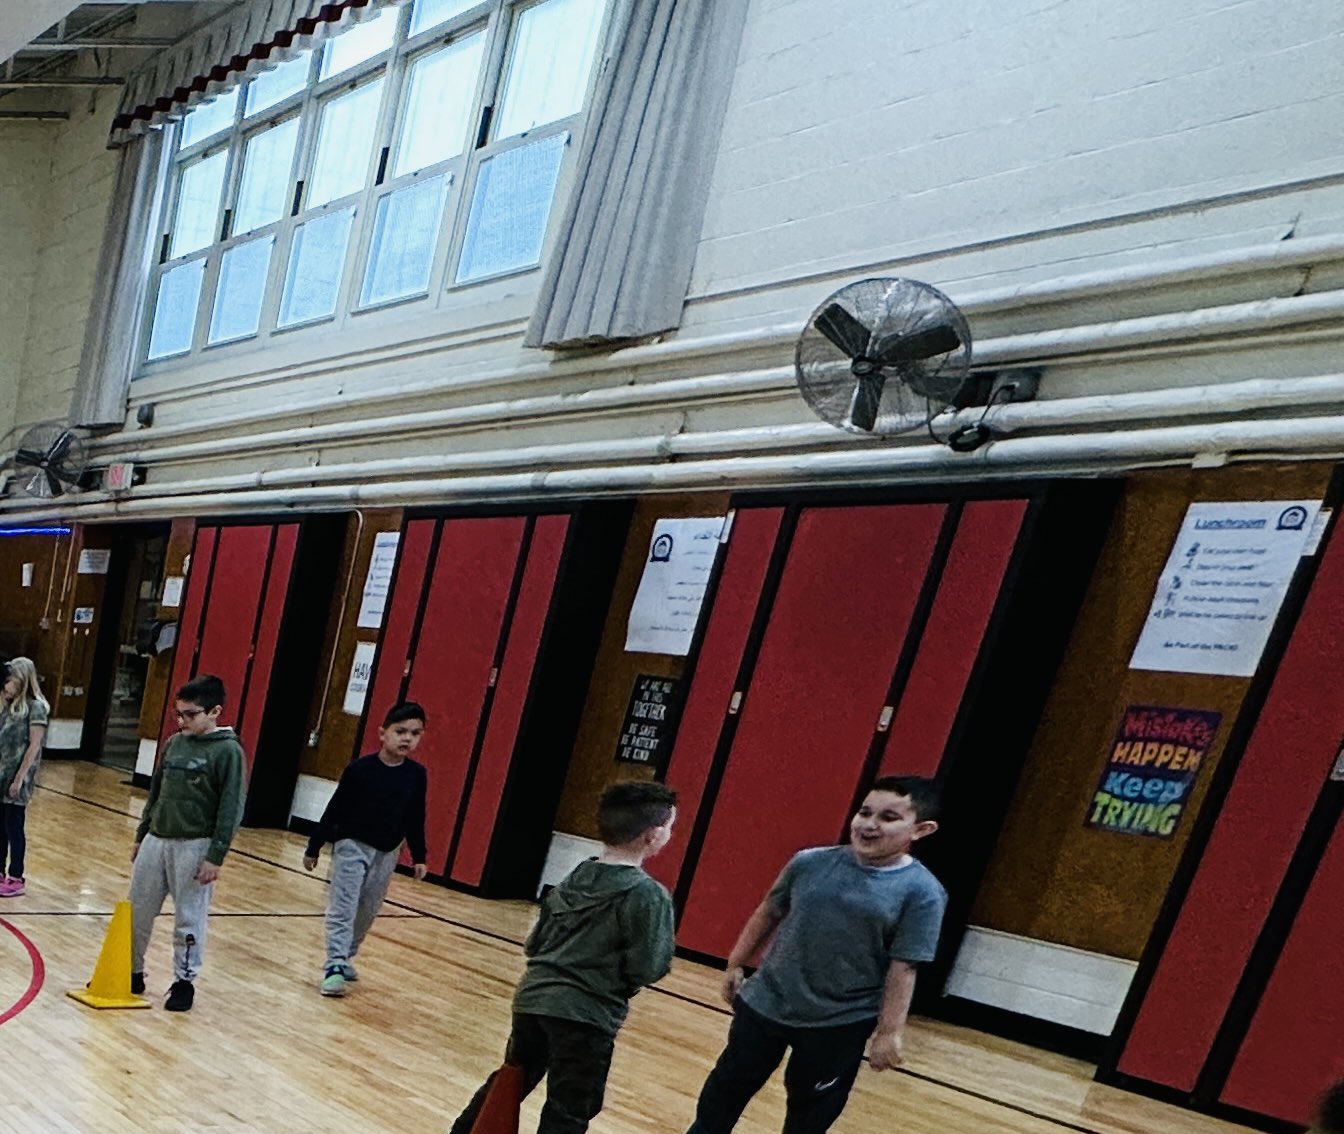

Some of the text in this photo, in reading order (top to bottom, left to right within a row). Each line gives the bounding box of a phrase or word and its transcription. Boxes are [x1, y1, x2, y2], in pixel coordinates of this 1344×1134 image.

[1194, 518, 1266, 530] Lunchroom
[632, 701, 666, 720] TOGETHER
[1112, 741, 1202, 771] HAPPEN
[1090, 791, 1181, 835] TRYING
